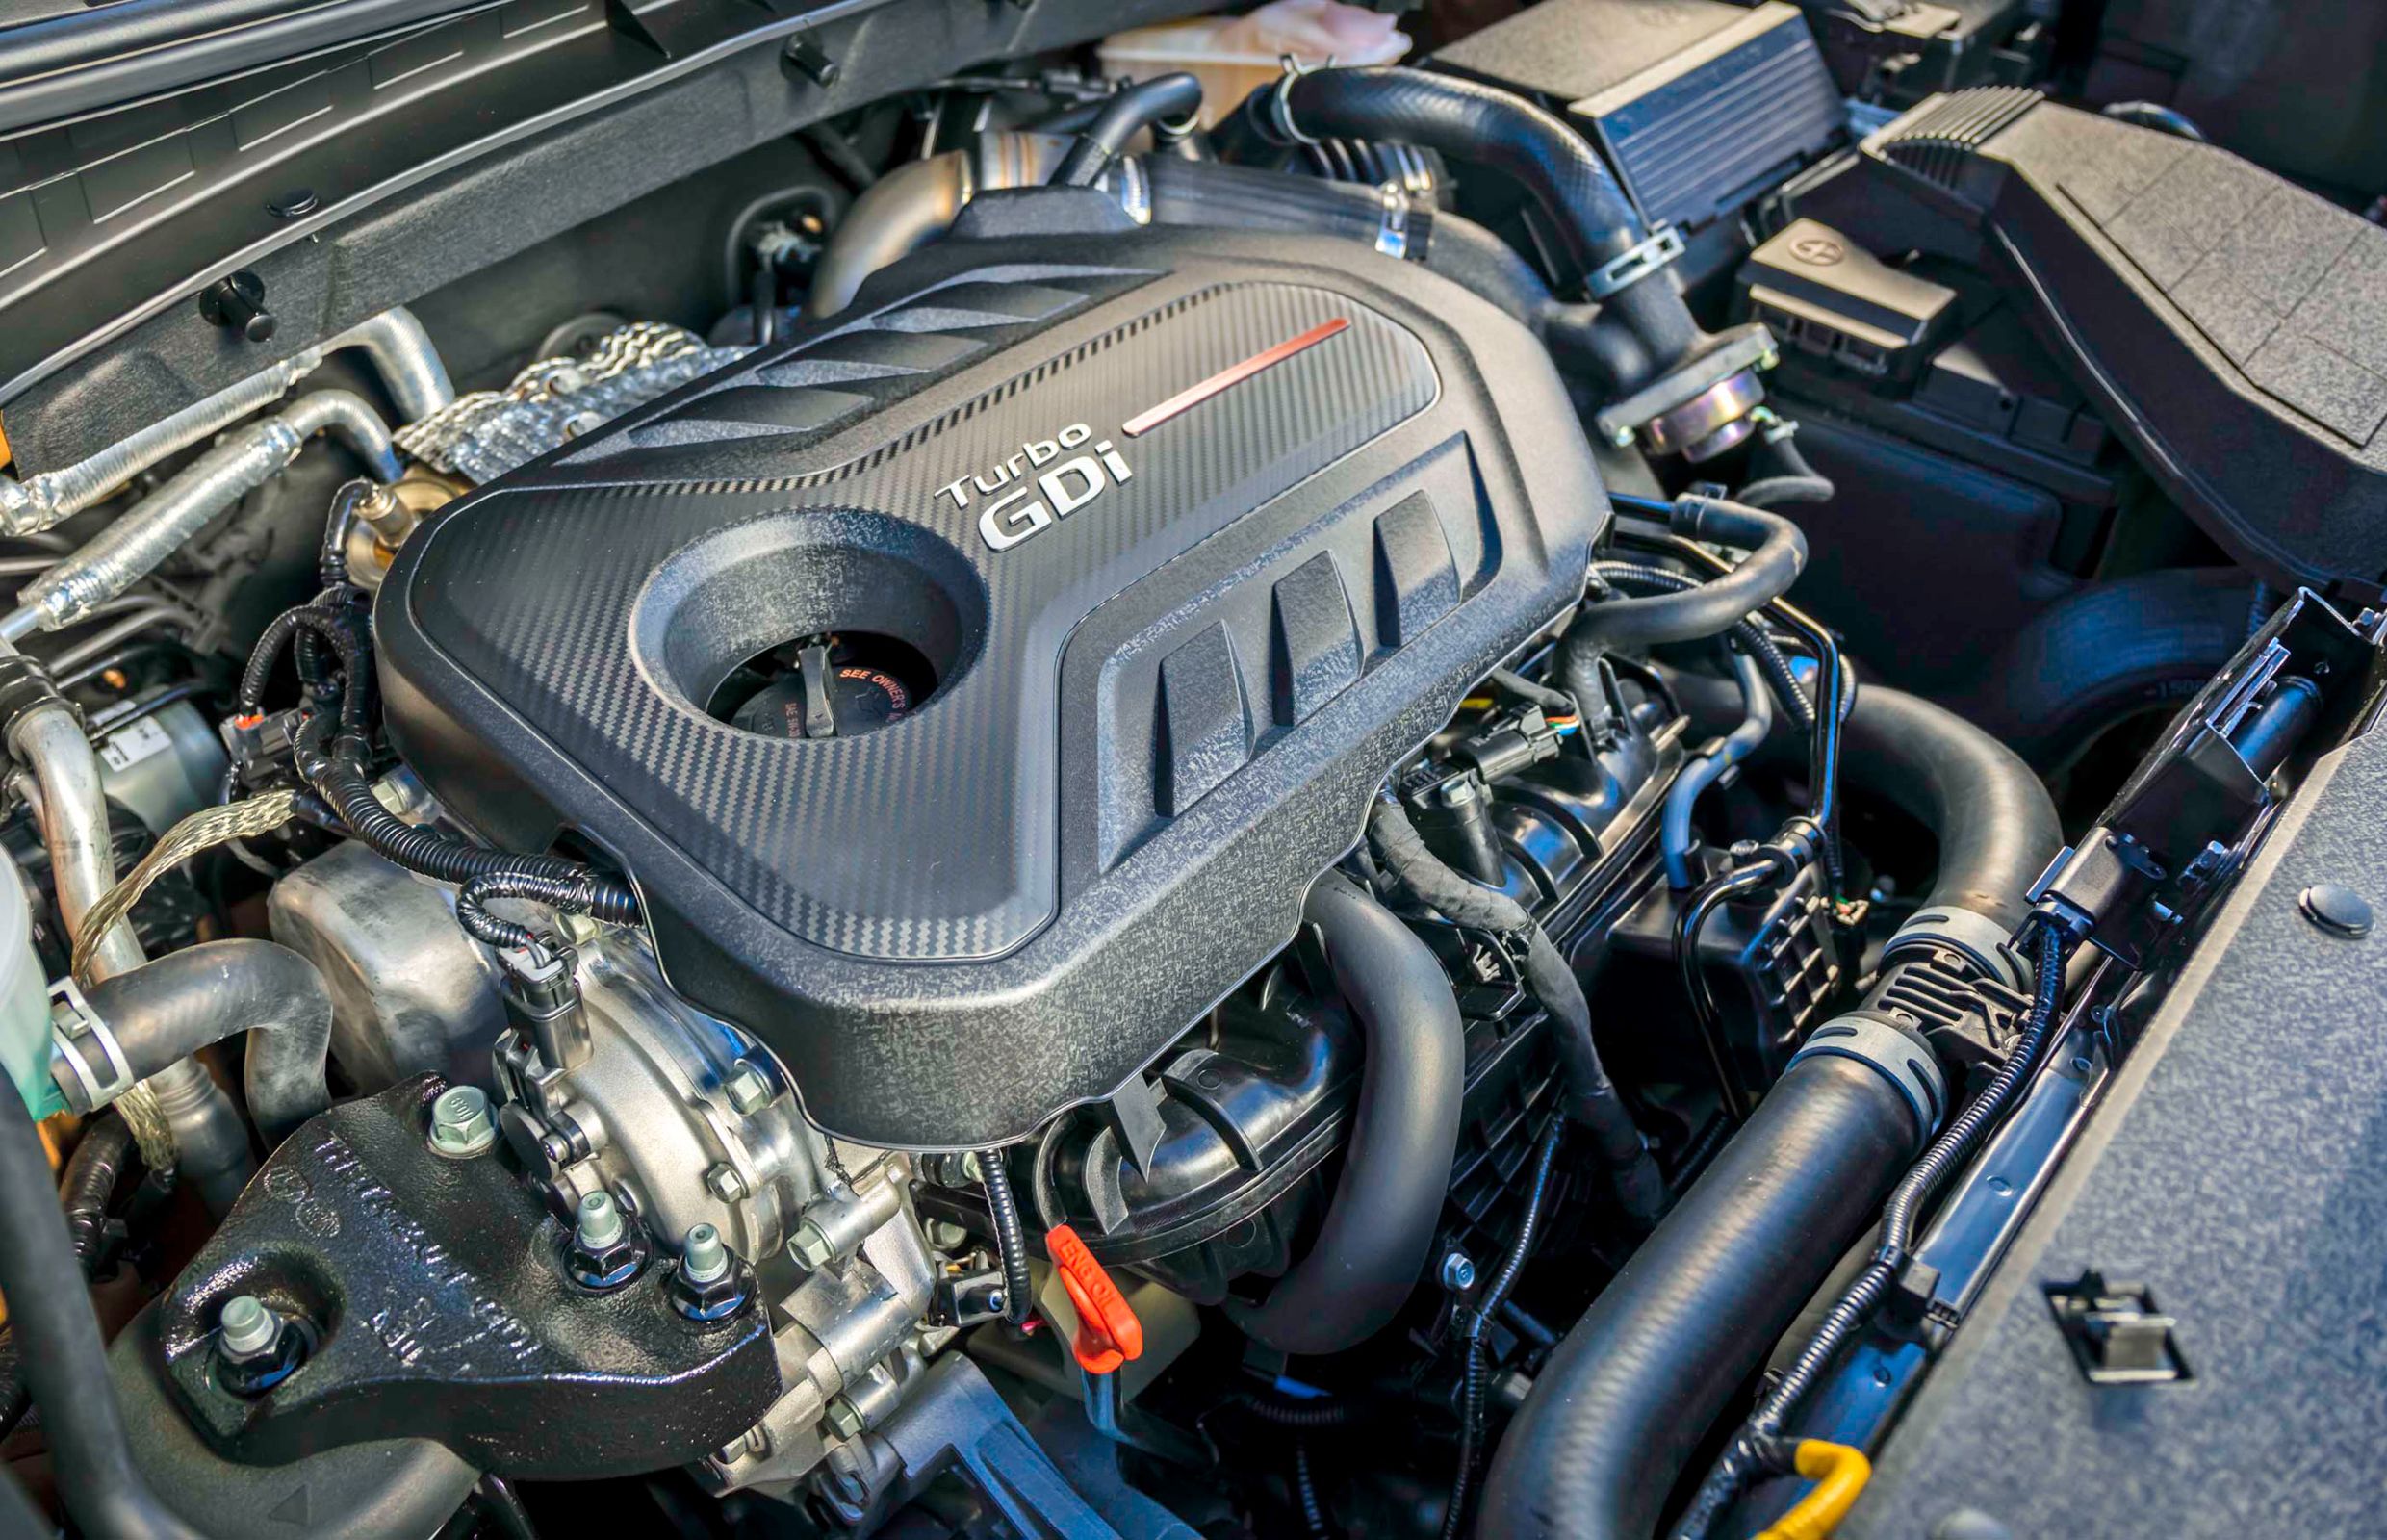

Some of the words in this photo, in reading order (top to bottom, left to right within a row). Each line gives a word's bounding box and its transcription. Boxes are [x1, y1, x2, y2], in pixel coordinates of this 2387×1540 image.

[934, 423, 1092, 508] Turbo
[978, 439, 1133, 553] GDi
[839, 668, 872, 680] SEE
[1059, 1239, 1093, 1280] ENG
[1090, 1281, 1114, 1318] OIL
